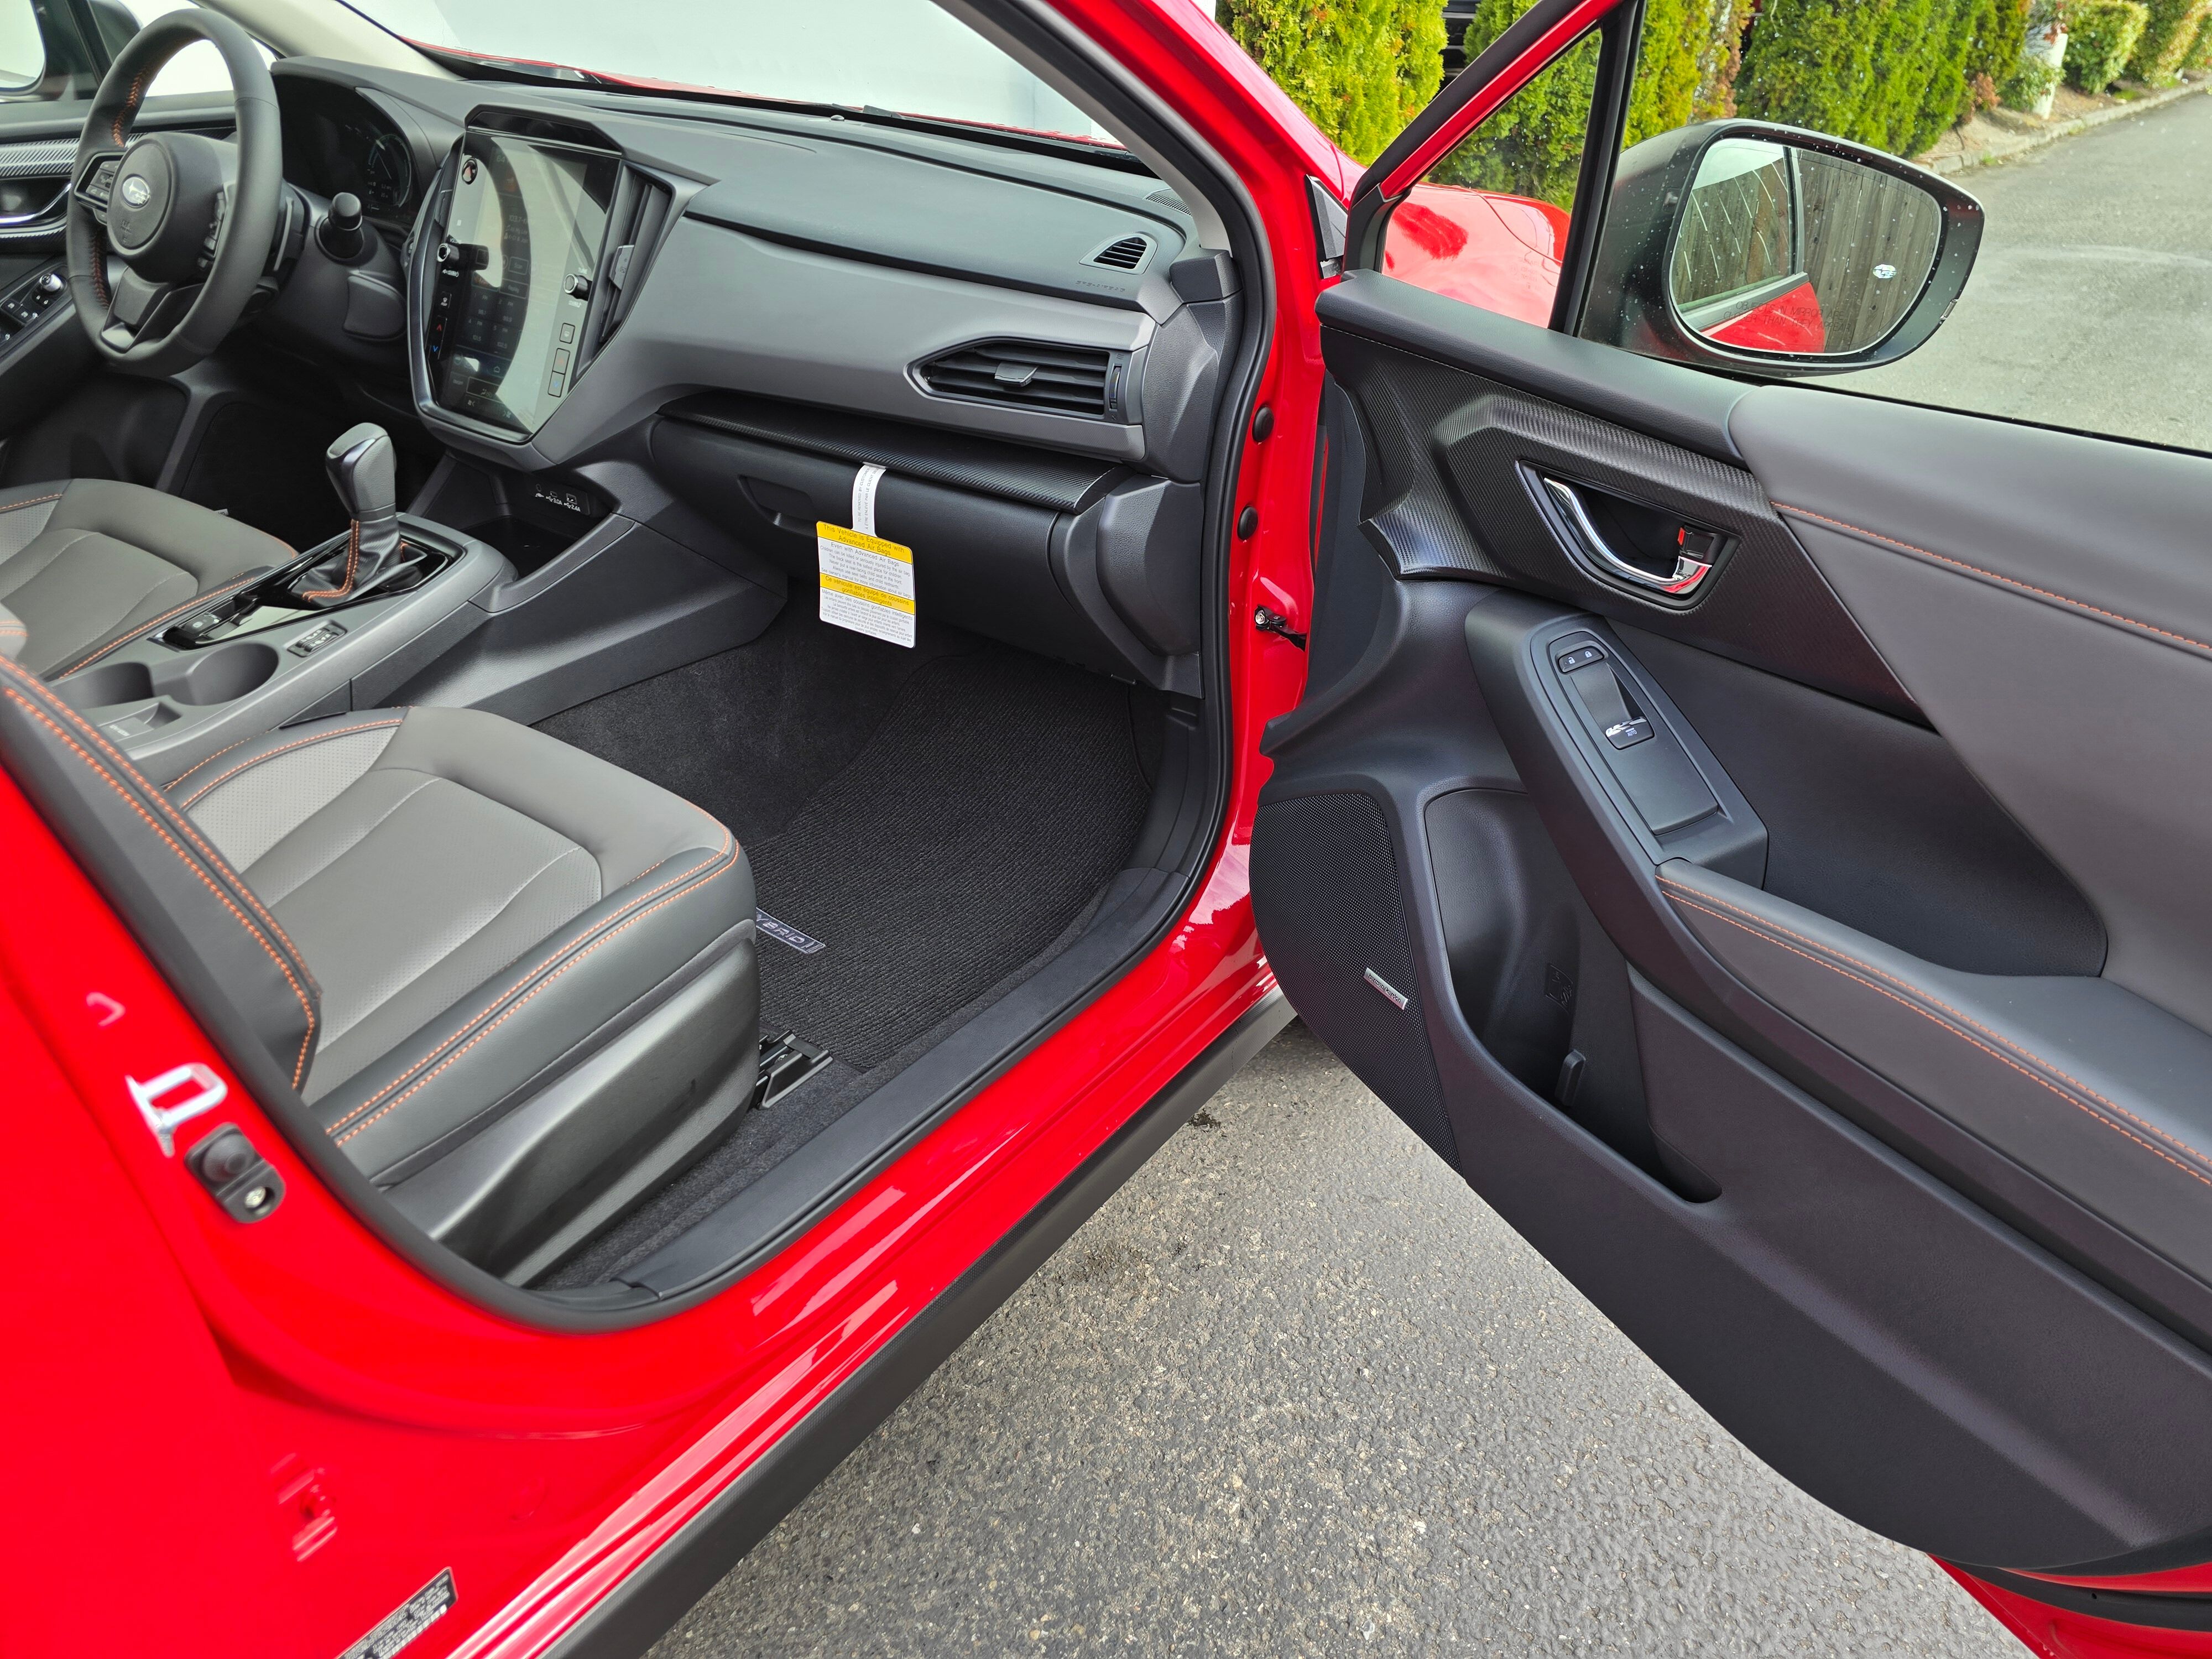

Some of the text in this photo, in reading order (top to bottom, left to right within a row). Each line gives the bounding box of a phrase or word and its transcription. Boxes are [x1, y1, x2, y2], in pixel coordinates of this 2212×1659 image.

[1735, 301, 1845, 320] OBJECTS IN MIRROR ARE
[1723, 311, 1851, 332] CLOSER THAN THEY APPEAR
[837, 528, 857, 539] Vehicle
[866, 536, 891, 549] Equipped
[838, 535, 865, 547] Advanced
[877, 546, 891, 556] Bags
[855, 548, 877, 560] Advanced
[888, 557, 899, 567] Bags
[834, 578, 852, 588] véhicule
[863, 587, 878, 597] équipé
[888, 594, 909, 605] coussins
[756, 912, 806, 943] YBRID
